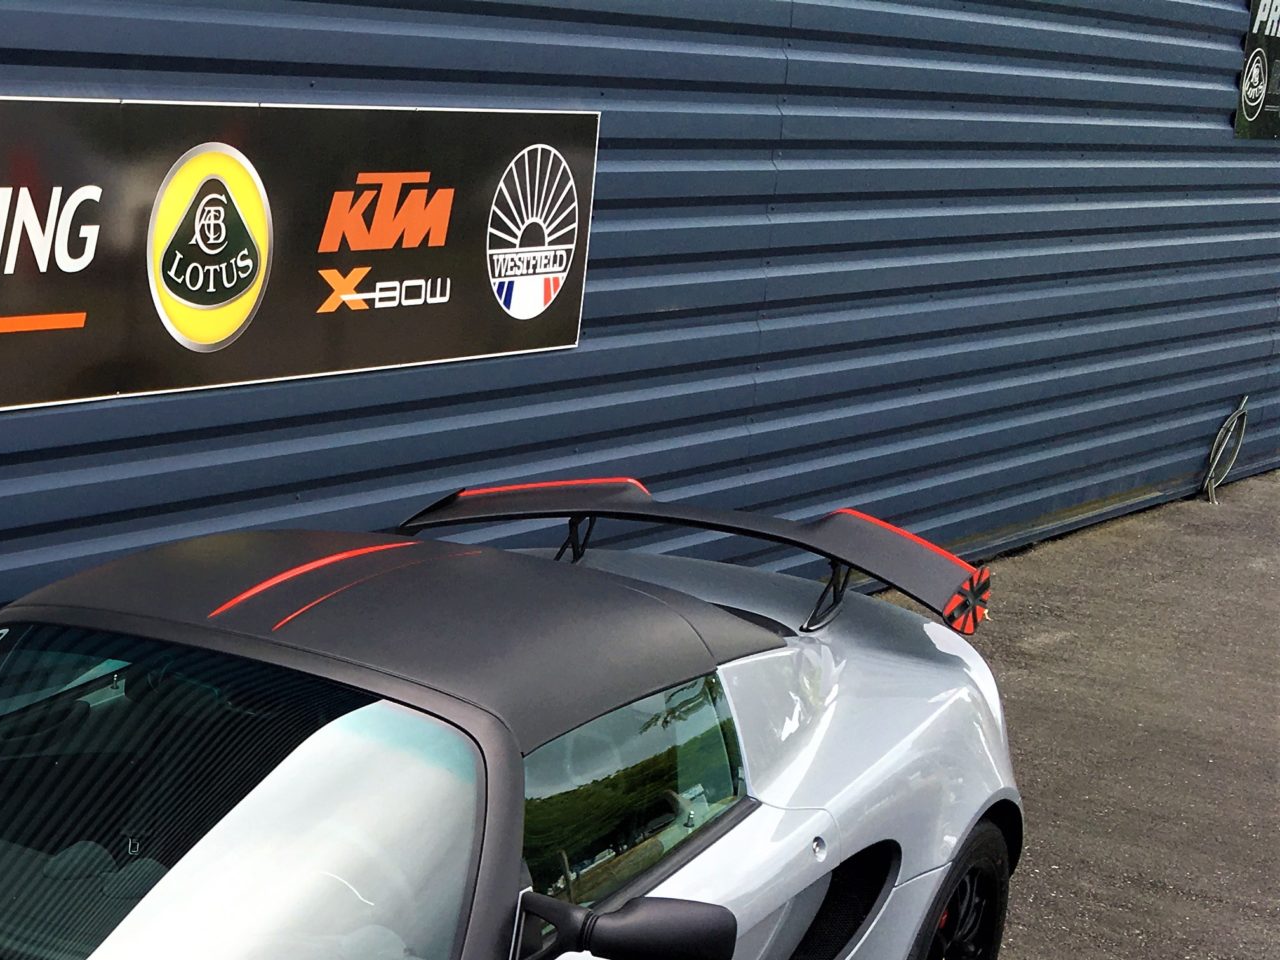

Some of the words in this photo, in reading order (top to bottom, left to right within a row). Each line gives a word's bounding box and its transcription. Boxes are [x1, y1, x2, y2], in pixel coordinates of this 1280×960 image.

[1252, 0, 1280, 38] PR
[317, 172, 455, 253] KTM
[167, 248, 253, 293] LOTUS
[493, 250, 567, 278] WESTFIELD
